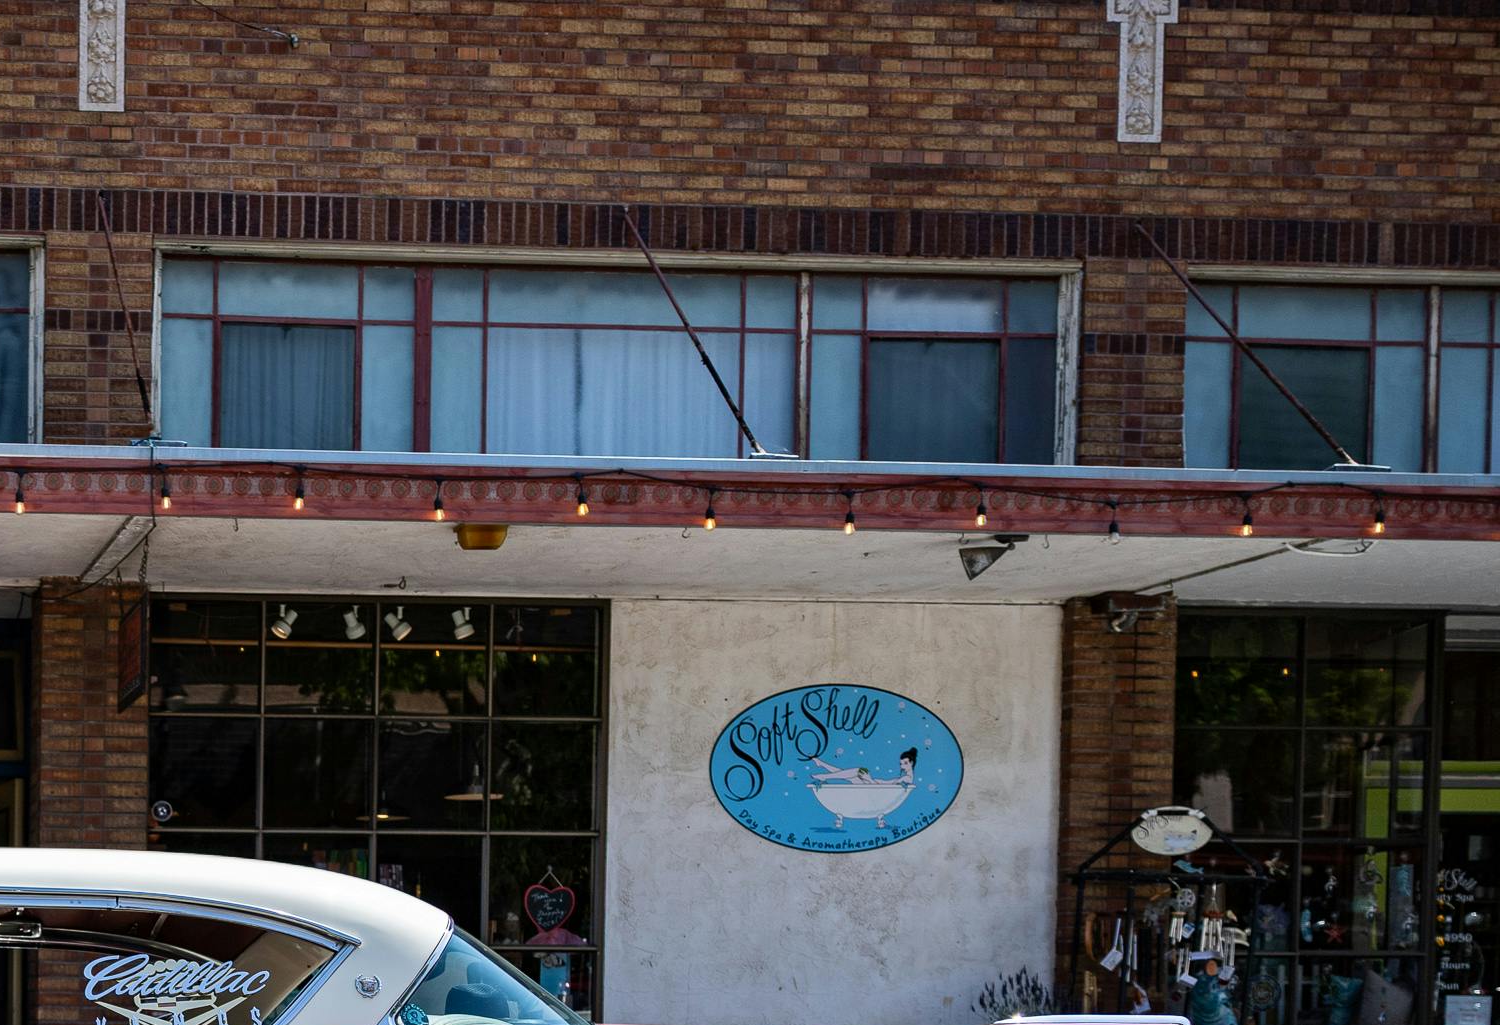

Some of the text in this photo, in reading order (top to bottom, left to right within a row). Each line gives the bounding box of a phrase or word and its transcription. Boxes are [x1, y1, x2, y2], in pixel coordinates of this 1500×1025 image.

[724, 687, 880, 801] Soft Shell
[738, 808, 941, 849] Day Spa & Aromatherapy Boutique
[84, 953, 270, 1001] Cadillac
